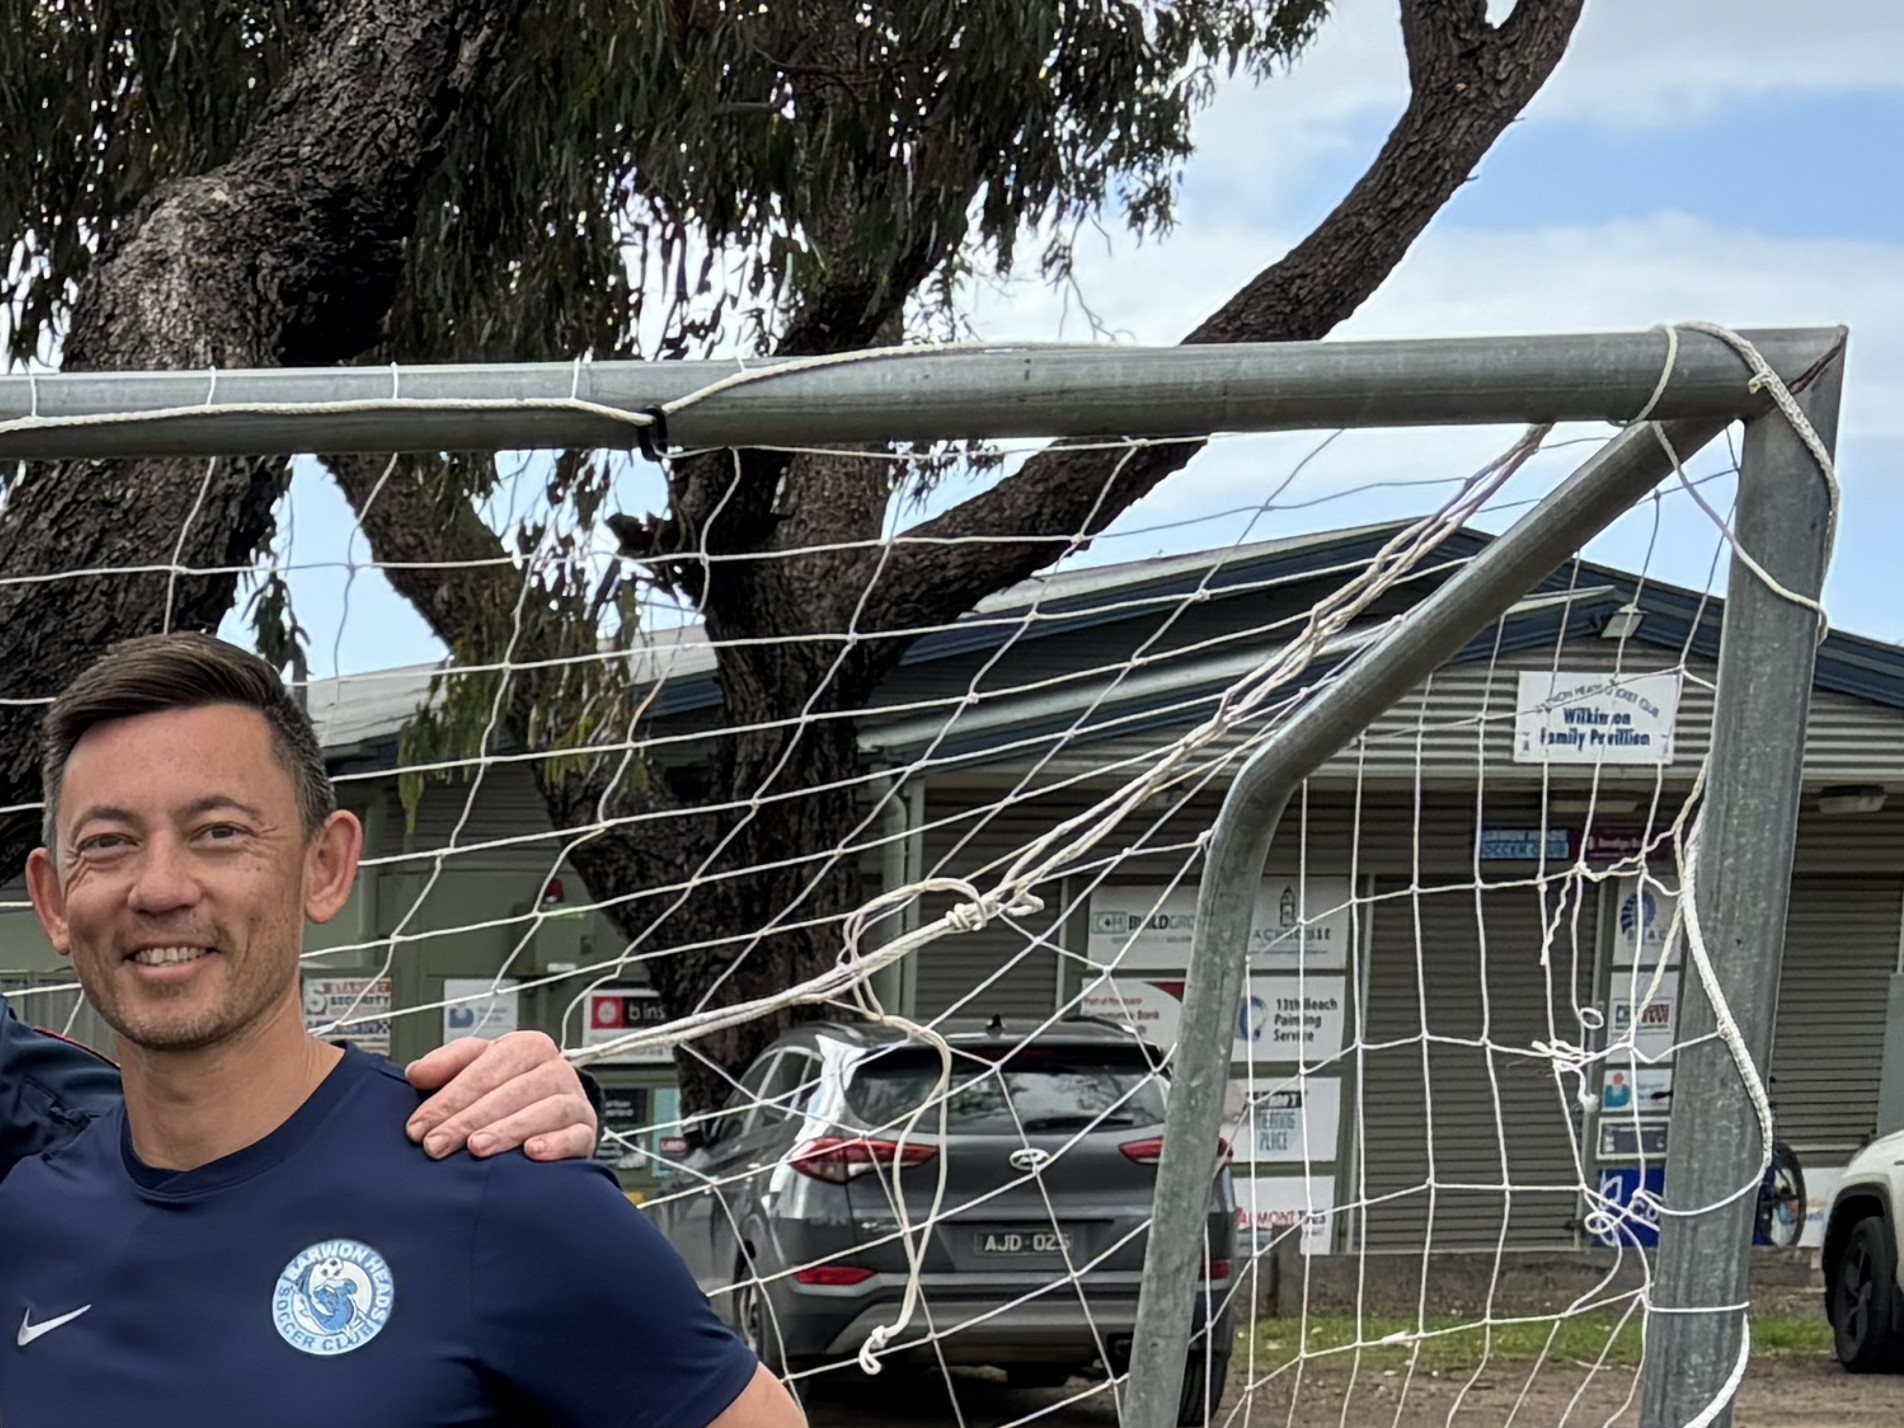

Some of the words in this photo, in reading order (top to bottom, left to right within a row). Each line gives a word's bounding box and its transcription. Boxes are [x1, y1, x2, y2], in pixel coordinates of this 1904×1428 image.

[277, 1286, 315, 1348] SOCCER
[322, 1326, 374, 1352] CLUB
[364, 1256, 391, 1320] HEADS
